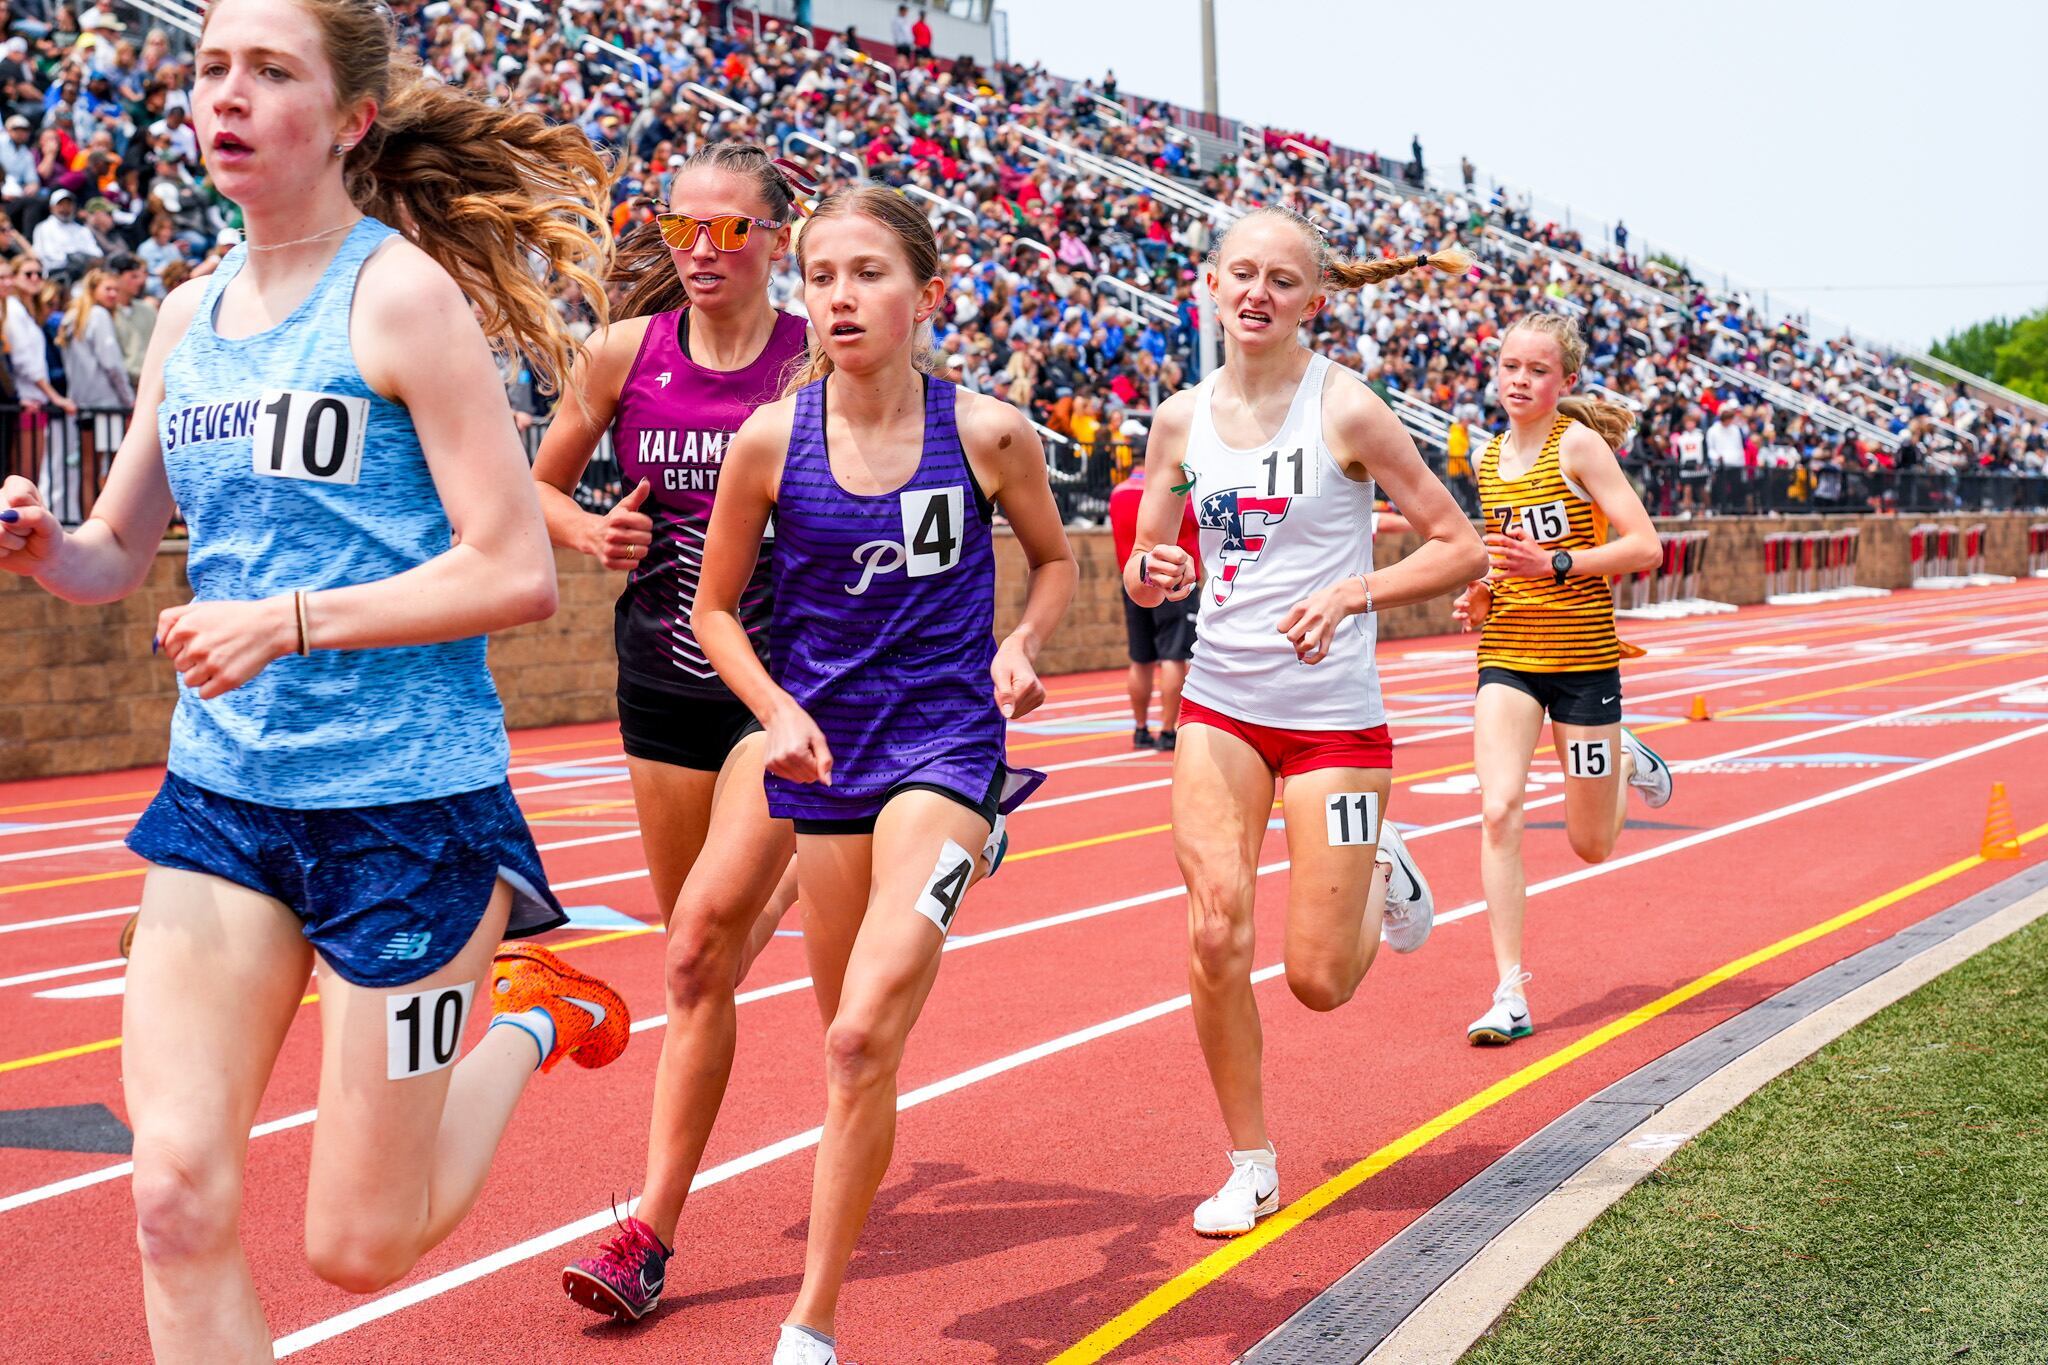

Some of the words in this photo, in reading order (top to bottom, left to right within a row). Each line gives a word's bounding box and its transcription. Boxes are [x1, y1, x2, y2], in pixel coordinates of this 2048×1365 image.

[265, 392, 349, 477] 10
[638, 430, 737, 464] KALAM
[1262, 448, 1304, 497] 11
[912, 493, 957, 568] 4
[1524, 504, 1563, 541] 15
[844, 539, 907, 596] P
[1570, 742, 1606, 775] 15
[1330, 794, 1369, 843] 11
[929, 858, 972, 928] 4
[395, 989, 463, 1073] 10
